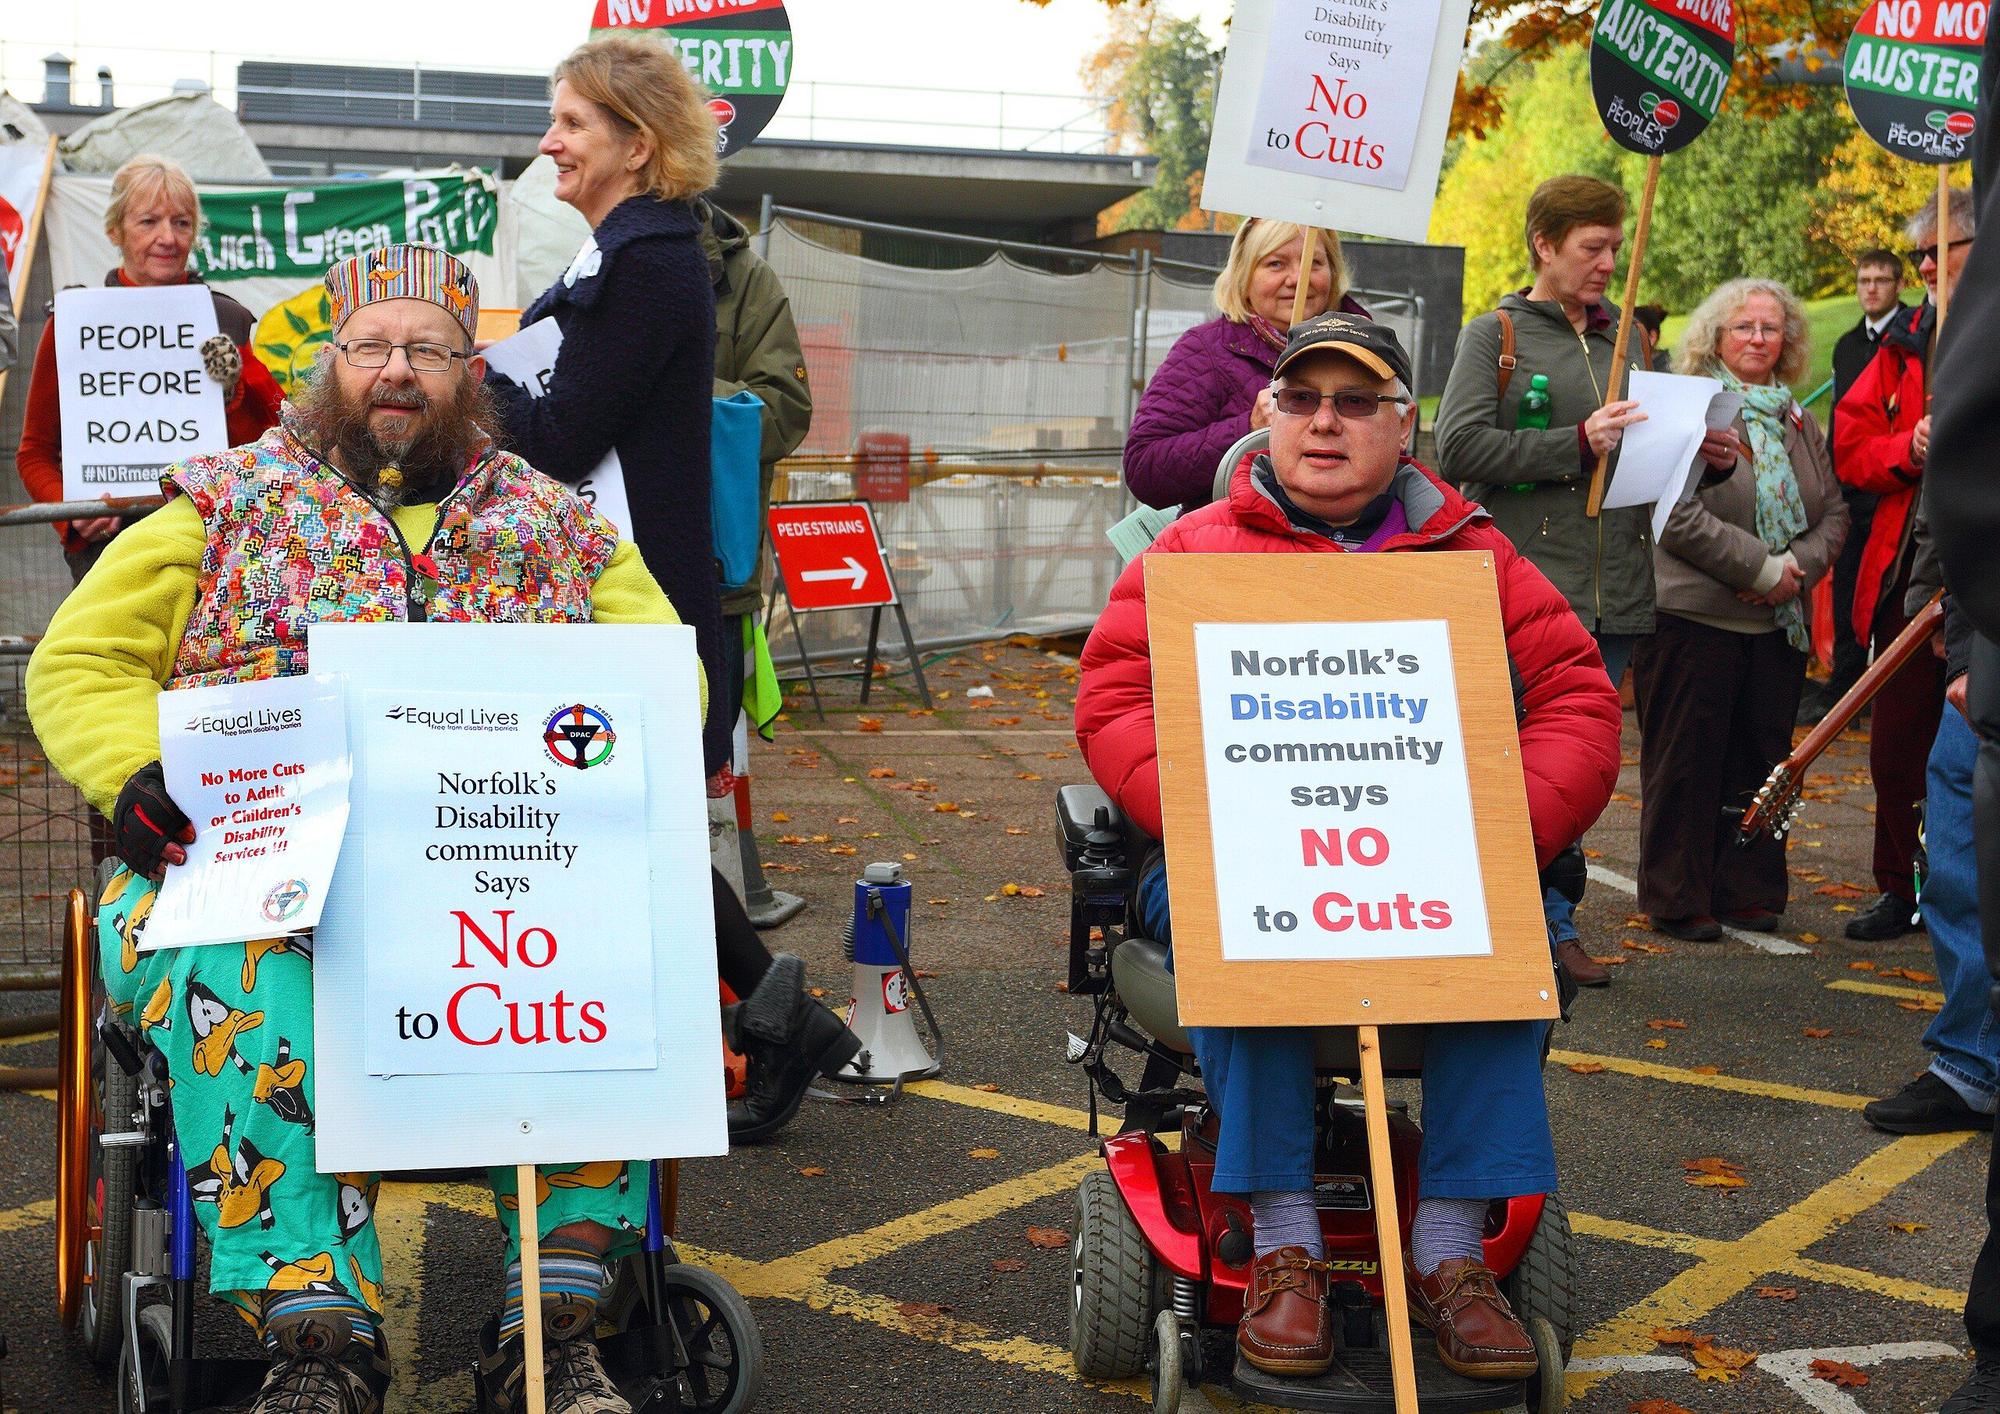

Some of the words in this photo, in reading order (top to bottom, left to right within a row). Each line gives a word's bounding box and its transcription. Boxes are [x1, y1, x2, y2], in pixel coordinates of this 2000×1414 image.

[1315, 7, 1386, 37] Disability
[1875, 0, 1922, 38] NO
[1934, 1, 1987, 40] MO
[1304, 30, 1392, 59] community
[1597, 0, 1728, 115] AUSTERITY
[667, 38, 790, 88] ERITY
[1328, 51, 1361, 73] Says
[1849, 42, 1979, 105] AUSTER
[1305, 74, 1368, 119] No
[1266, 127, 1290, 149] to
[1295, 121, 1385, 170] Cuts
[1887, 127, 1966, 153] PEOPLE'S
[283, 190, 393, 265] Green
[80, 324, 195, 350] PEOPLE
[79, 370, 202, 396] BEFORE
[87, 419, 200, 444] ROADS
[776, 519, 866, 538] PEDESTRIANS
[202, 710, 253, 735] Equal
[259, 708, 302, 726] Lives
[406, 707, 464, 727] Equal
[471, 708, 519, 725] Lives
[1230, 691, 1429, 724] Disability
[1224, 735, 1444, 766] community
[201, 772, 224, 787] No
[228, 768, 268, 783] More
[272, 763, 305, 777] Cuts
[224, 792, 241, 804] to
[246, 785, 285, 802] Adult
[1290, 784, 1390, 812] says
[211, 816, 227, 827] or
[232, 803, 302, 824] Children's
[434, 804, 560, 837] Disability
[223, 826, 286, 845] Disability
[1300, 826, 1390, 867] NO
[214, 847, 267, 864] Services
[425, 838, 578, 869] community
[474, 870, 530, 900] Says
[1253, 905, 1298, 932] to
[1312, 891, 1453, 933] Cuts
[450, 910, 558, 969] No
[395, 1005, 439, 1040] to
[446, 982, 608, 1046] Cuts
